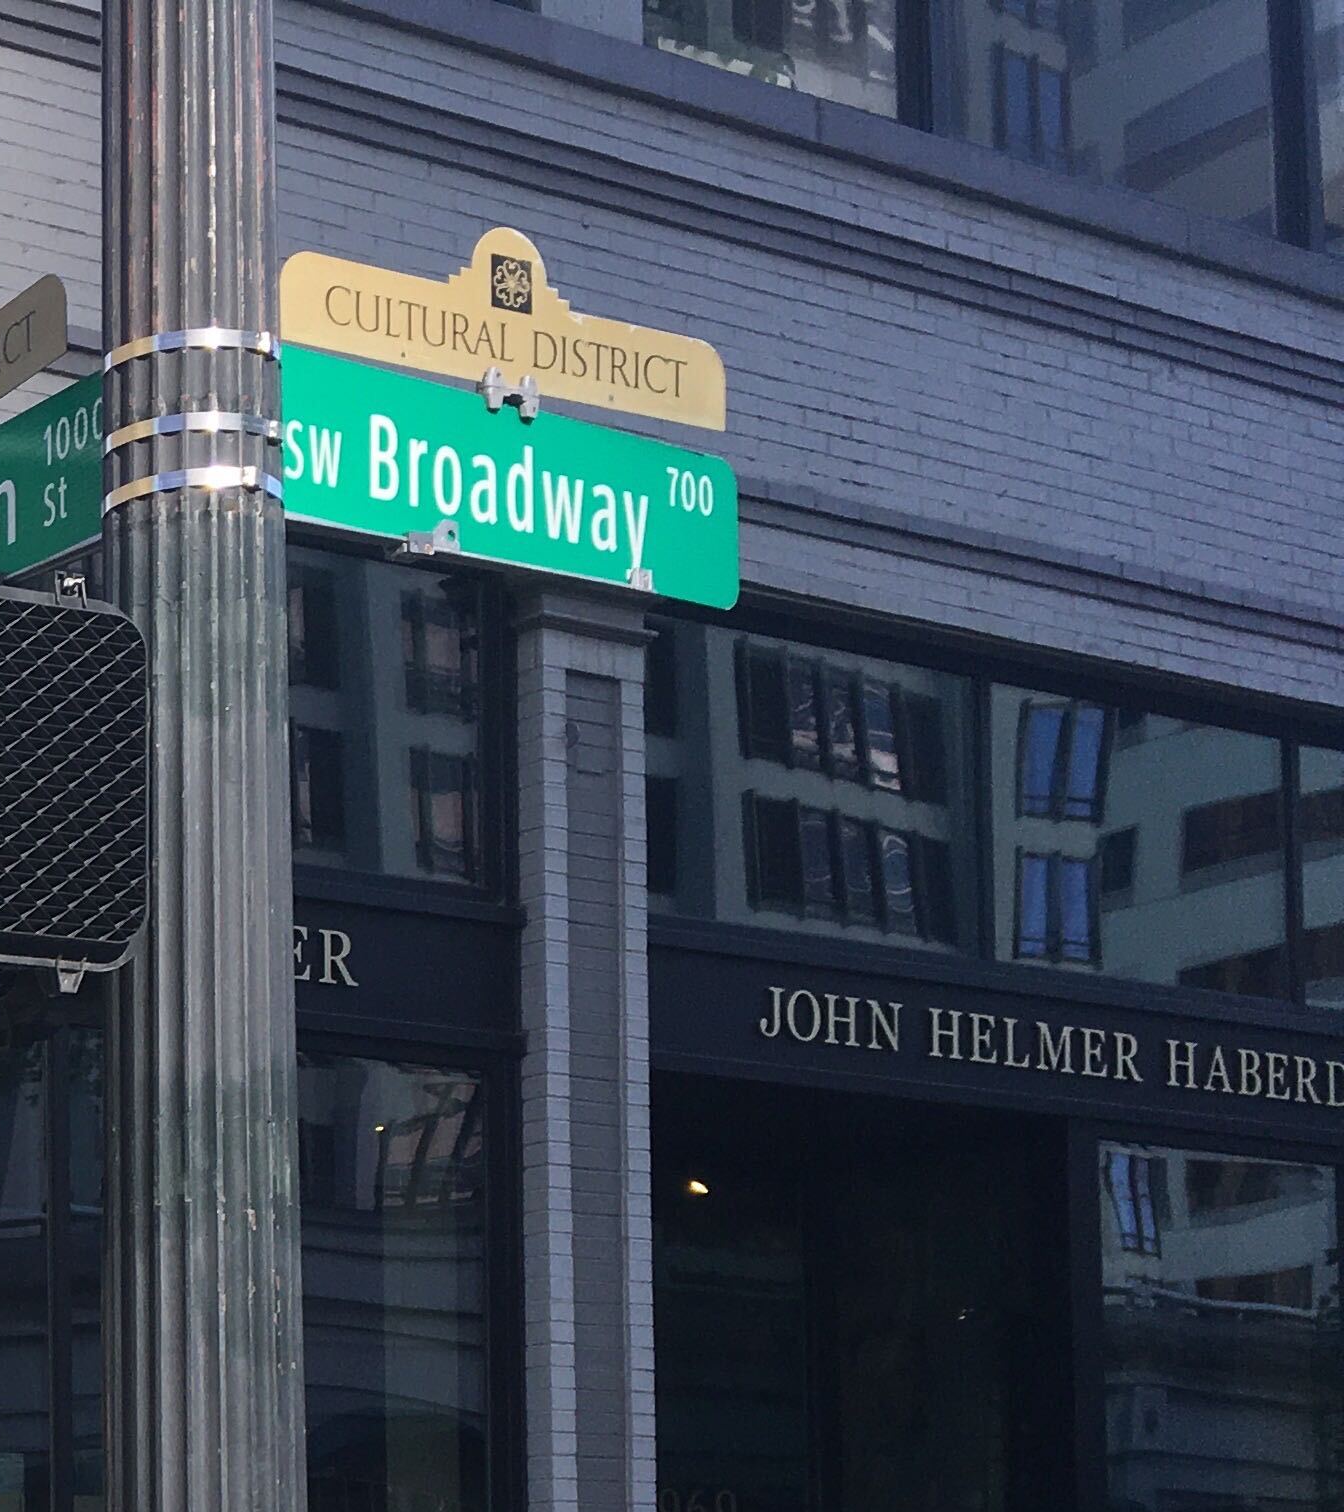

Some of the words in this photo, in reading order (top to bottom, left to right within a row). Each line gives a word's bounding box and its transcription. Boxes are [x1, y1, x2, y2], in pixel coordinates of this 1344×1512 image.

[324, 284, 514, 363] CULTURAL
[531, 329, 689, 399] DISTRICT
[43, 476, 68, 527] St
[283, 418, 342, 489] SW
[368, 413, 650, 571] Broadway
[665, 465, 713, 517] 700
[759, 985, 904, 1052] JOHN
[927, 1007, 1144, 1083] HELMER
